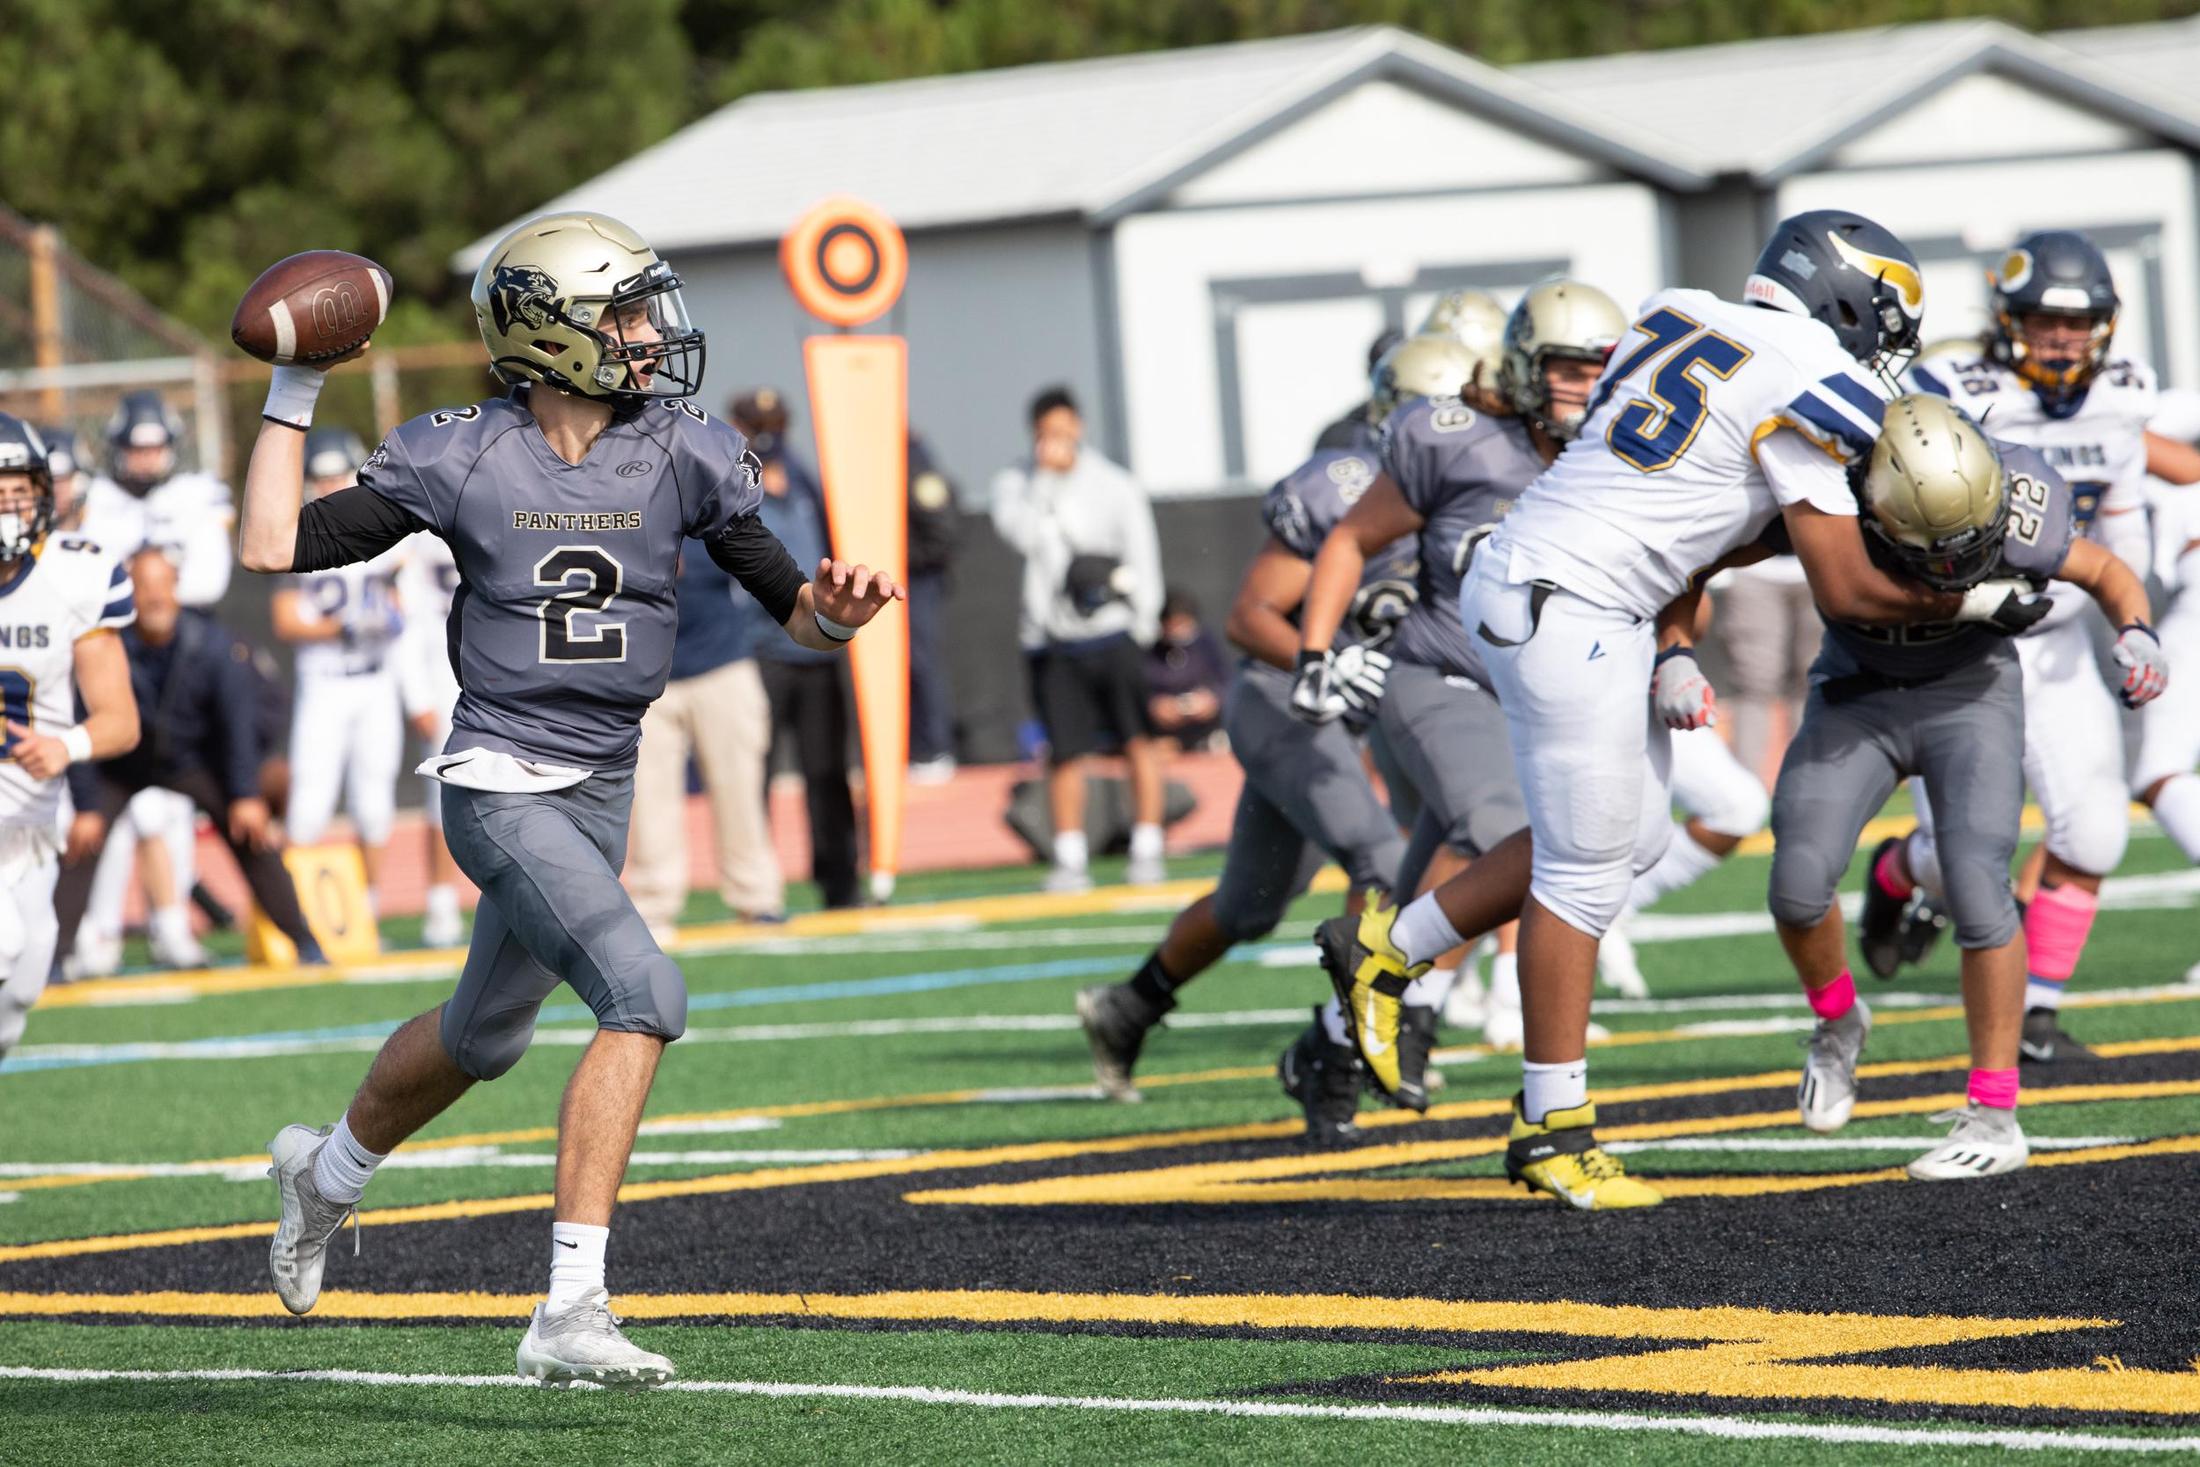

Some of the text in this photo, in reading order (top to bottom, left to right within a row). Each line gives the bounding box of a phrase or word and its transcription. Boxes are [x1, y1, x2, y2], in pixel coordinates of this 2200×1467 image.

[661, 397, 707, 425] 2
[1576, 305, 1754, 473] 75
[430, 405, 481, 427] 2
[513, 511, 642, 531] PANTHERS
[2006, 470, 2050, 547] 22
[534, 545, 627, 664] 2
